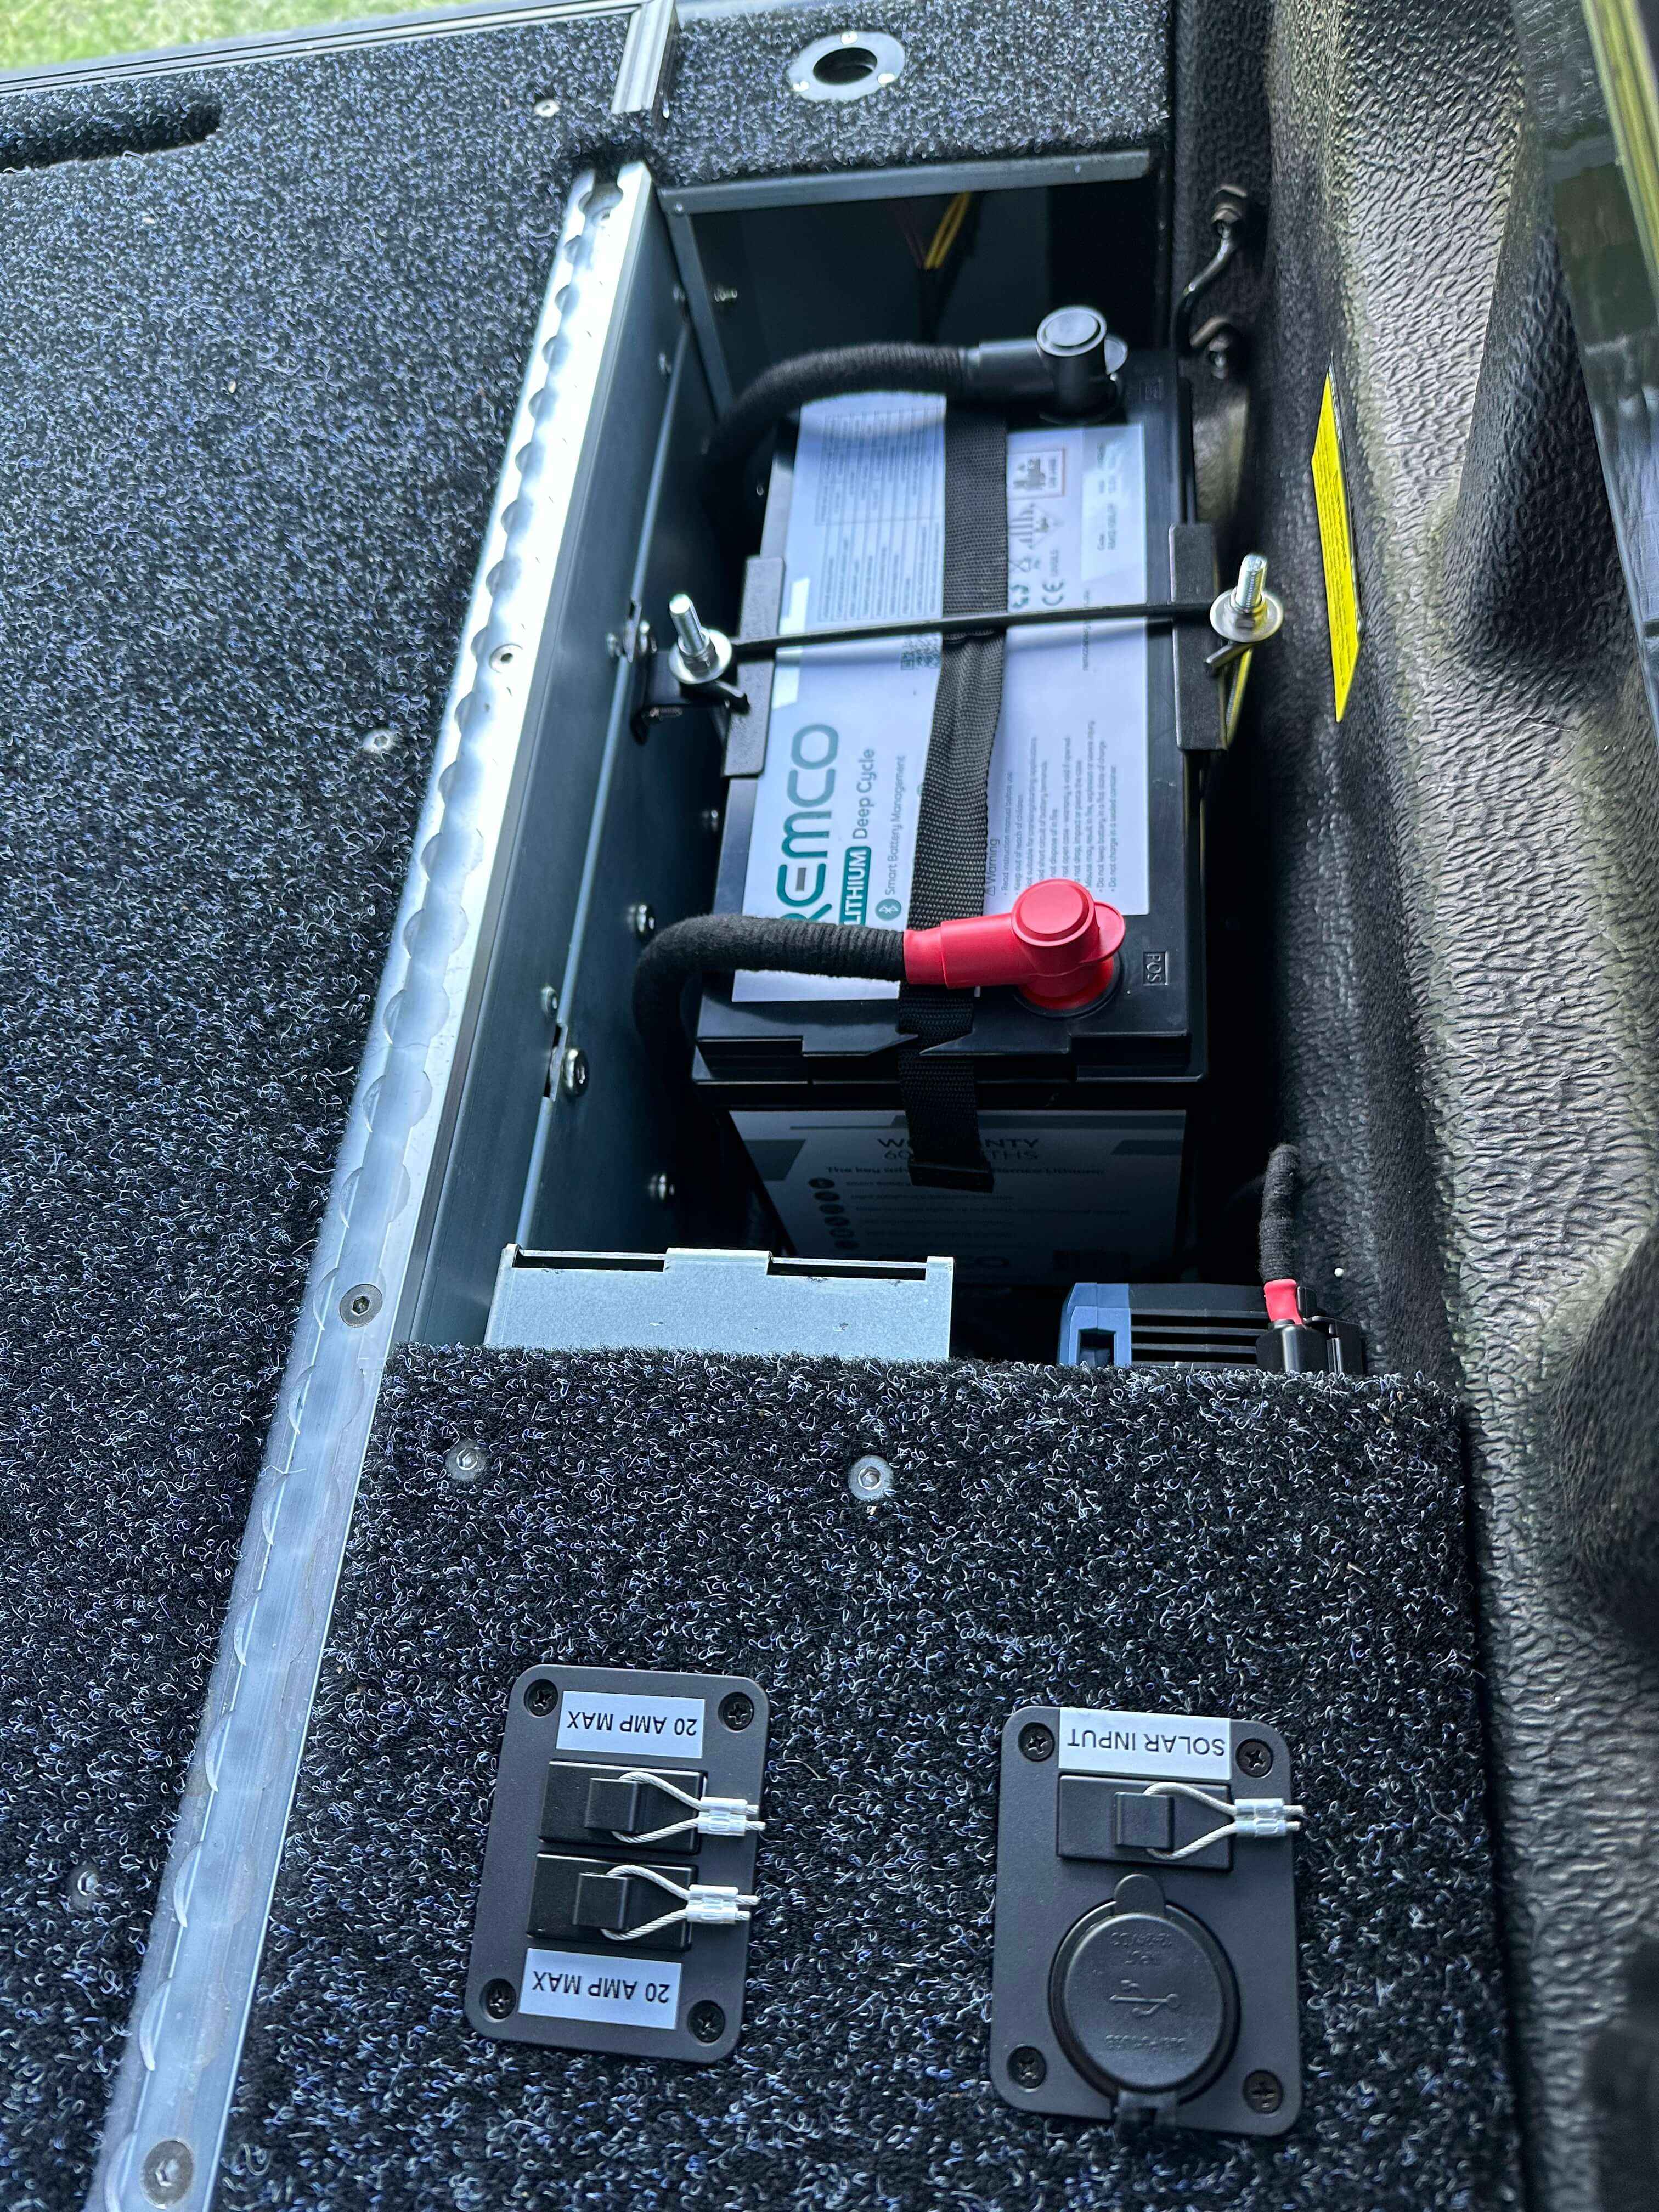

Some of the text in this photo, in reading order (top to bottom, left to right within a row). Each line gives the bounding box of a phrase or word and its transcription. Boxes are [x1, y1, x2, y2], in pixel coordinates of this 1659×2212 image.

[1039, 793, 1048, 820] battery
[1063, 791, 1072, 822] warranty
[1107, 799, 1116, 822] sealed
[843, 749, 876, 924] LITHIUM Deep Cycle
[885, 755, 906, 895] Smart Battery Management
[1072, 820, 1082, 845] impact
[1084, 826, 1093, 845] result
[1096, 817, 1106, 844] battery
[986, 838, 1000, 883] Warning
[1014, 850, 1022, 859] of
[1050, 838, 1059, 865] dispose
[1062, 846, 1071, 864] open
[1085, 846, 1094, 863] may
[1095, 845, 1105, 863] keep
[1107, 837, 1118, 862] charge
[1001, 873, 1009, 891] Read
[1049, 866, 1058, 878] not
[1096, 877, 1104, 888] Do
[1107, 877, 1116, 887] Do
[1146, 953, 1163, 983] POS
[877, 1138, 1039, 1148] WNTY
[884, 1150, 913, 1160] 60
[567, 1711, 698, 1736] 20 AMP MAX
[1067, 1729, 1225, 1756] SOLAR INPUT
[532, 1971, 670, 2003] 20 AMP MAX
